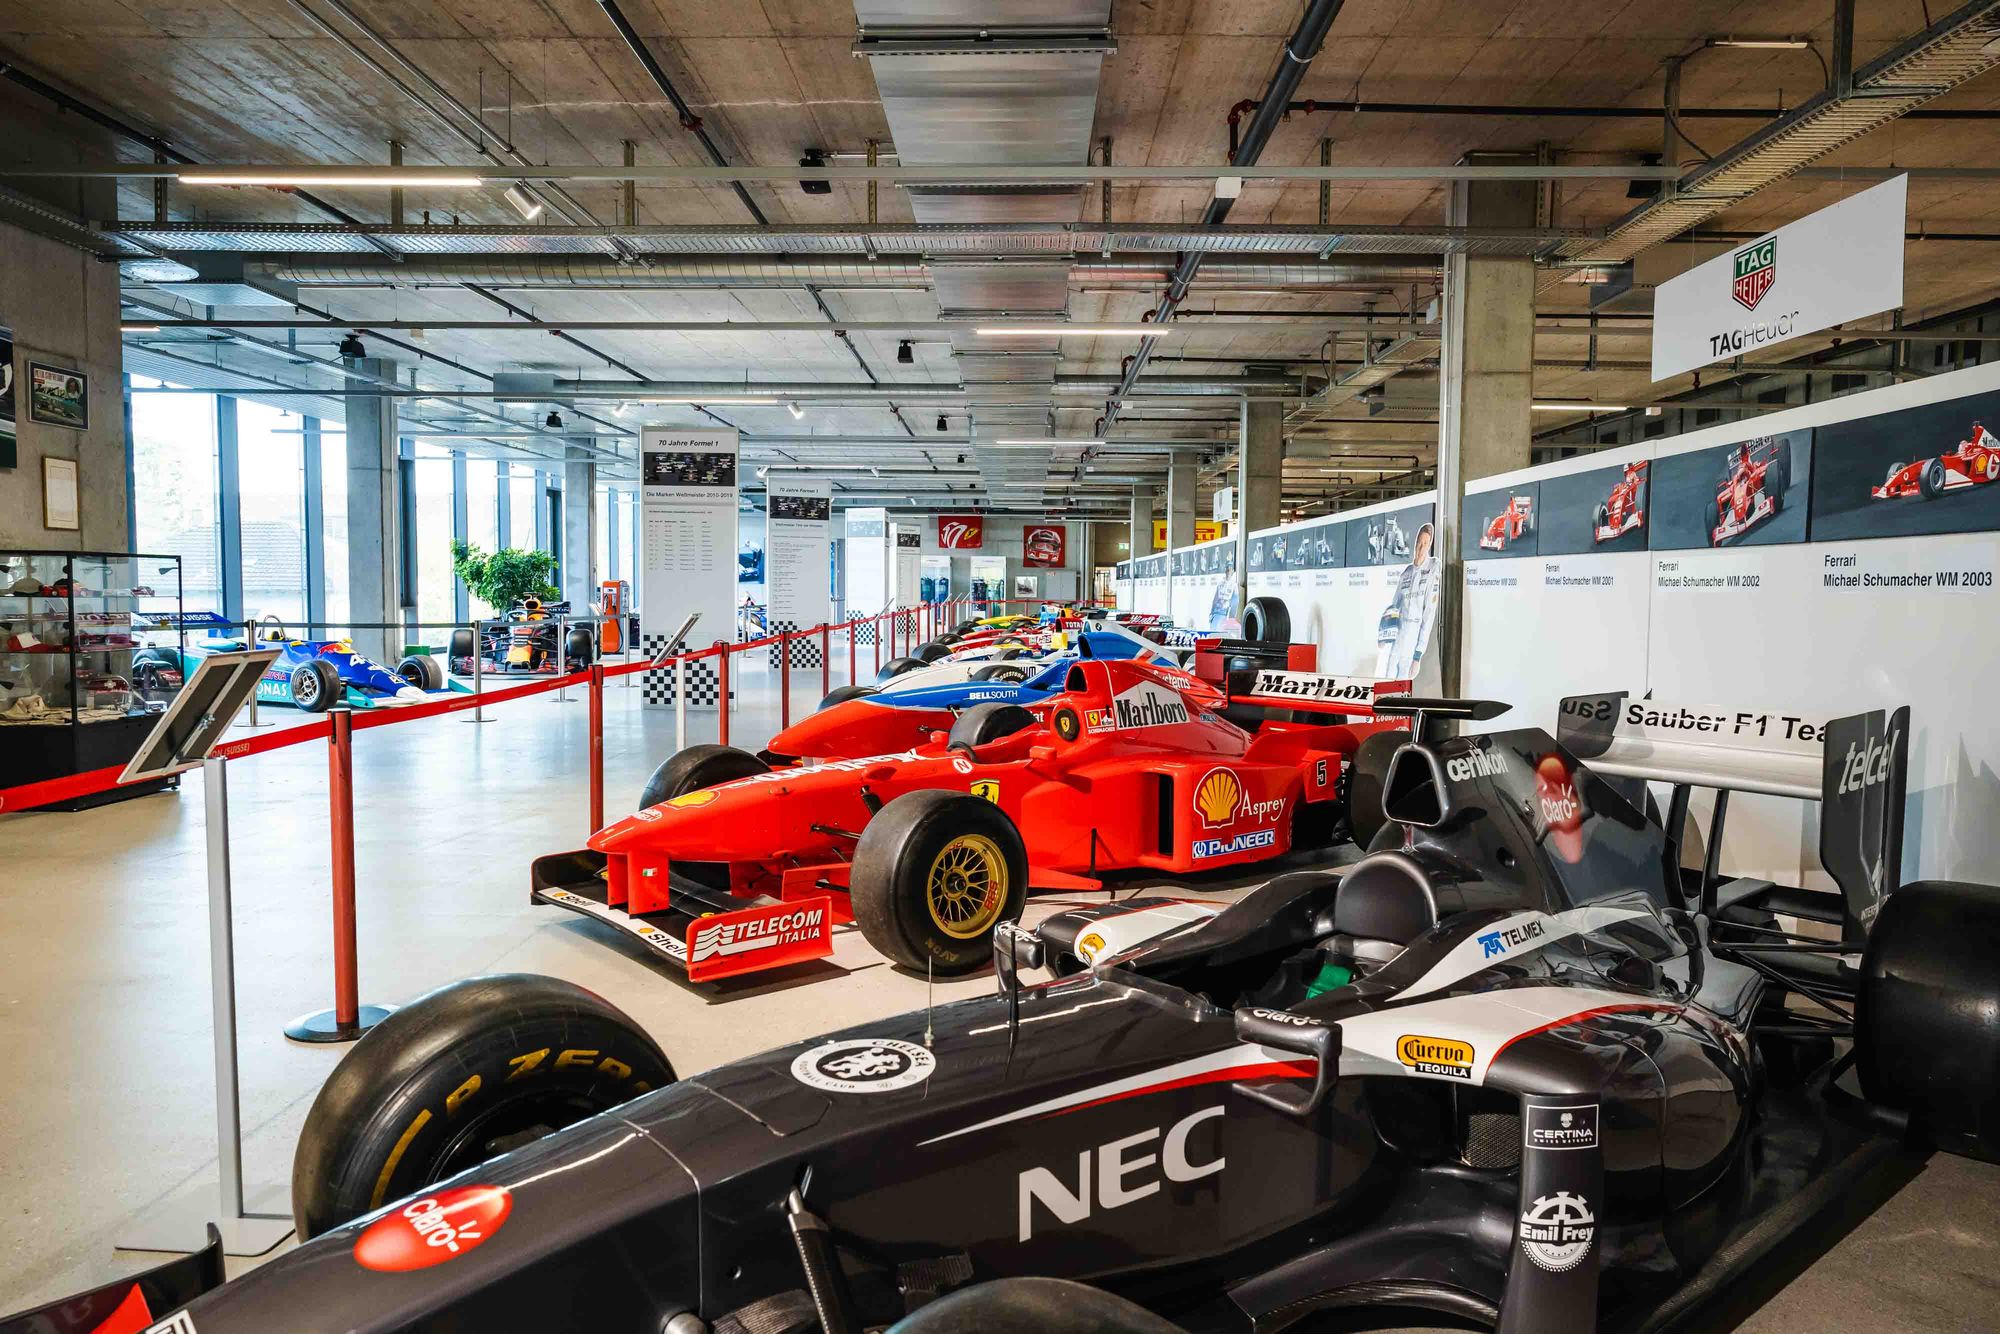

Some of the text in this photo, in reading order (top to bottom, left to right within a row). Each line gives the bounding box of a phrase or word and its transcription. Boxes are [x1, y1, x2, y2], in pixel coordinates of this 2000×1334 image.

[1737, 244, 1772, 275] TAG
[1735, 267, 1773, 305] HEUER
[1545, 564, 1560, 572] Ferrari
[1658, 561, 1679, 571] Ferrari
[1824, 554, 1856, 567] Ferrari
[1545, 576, 1614, 586] Michael Schumacher WM 2001
[1658, 575, 1760, 587] Michael Schumacher WM 2002
[1823, 571, 1992, 587] Michael Schumacher WM 2003
[256, 682, 287, 697] ONAS
[969, 690, 1018, 700] BELLSOUTH
[1258, 674, 1374, 700] Marlbor
[1115, 692, 1187, 728] Marlboro
[1626, 704, 1726, 733] Sauber
[1781, 716, 1827, 743] Tea
[1316, 760, 1327, 786] 5
[1240, 789, 1286, 824] Asprey
[736, 908, 823, 939] TELECOM
[776, 926, 821, 945] ITALIA
[1501, 920, 1546, 947] TELMEX
[872, 1040, 931, 1068] CHELSEA
[1404, 1038, 1464, 1062] Cuervo
[1417, 1062, 1468, 1078] TEQUILA
[1532, 1128, 1593, 1139] CERTINA
[1019, 1104, 1226, 1243] NEC
[402, 1198, 457, 1248] Claro
[1520, 1222, 1595, 1242] Emil Frey
